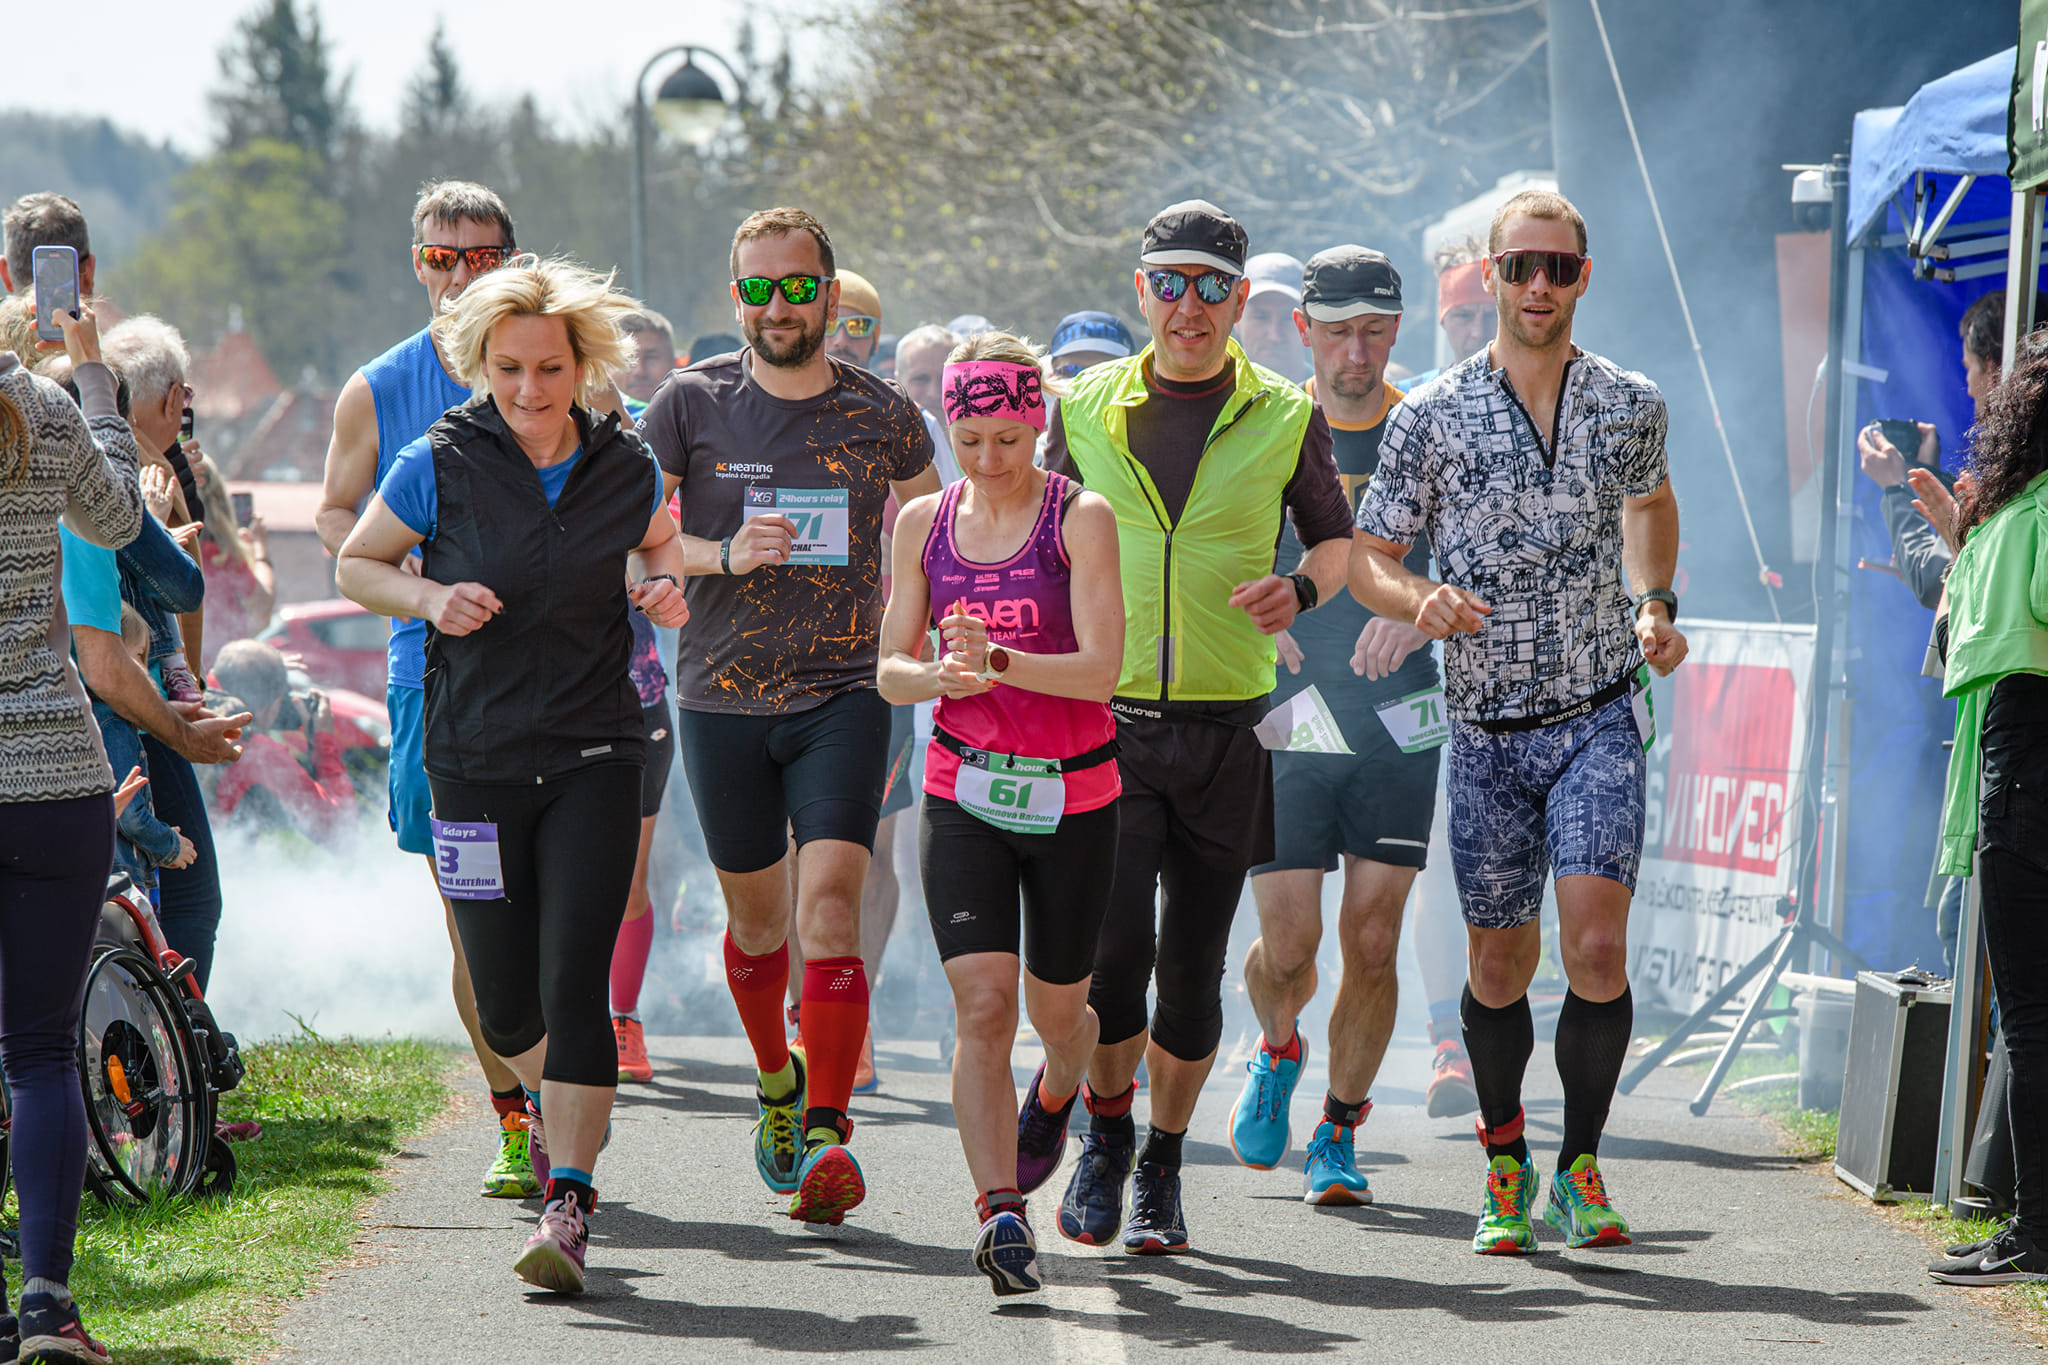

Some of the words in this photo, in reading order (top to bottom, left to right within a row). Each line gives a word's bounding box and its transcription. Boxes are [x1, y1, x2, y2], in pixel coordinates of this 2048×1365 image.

[715, 462, 728, 471] AC
[779, 493, 818, 503] 24hours
[820, 494, 845, 504] relay
[783, 512, 823, 540] 71
[993, 630, 1017, 641] TEAM
[1111, 702, 1161, 719] salomon
[1410, 698, 1441, 728] 71
[1541, 707, 1581, 726] salomon
[989, 778, 1033, 809] 61
[442, 827, 478, 840] 6days
[455, 878, 497, 887] KATEŘINA
